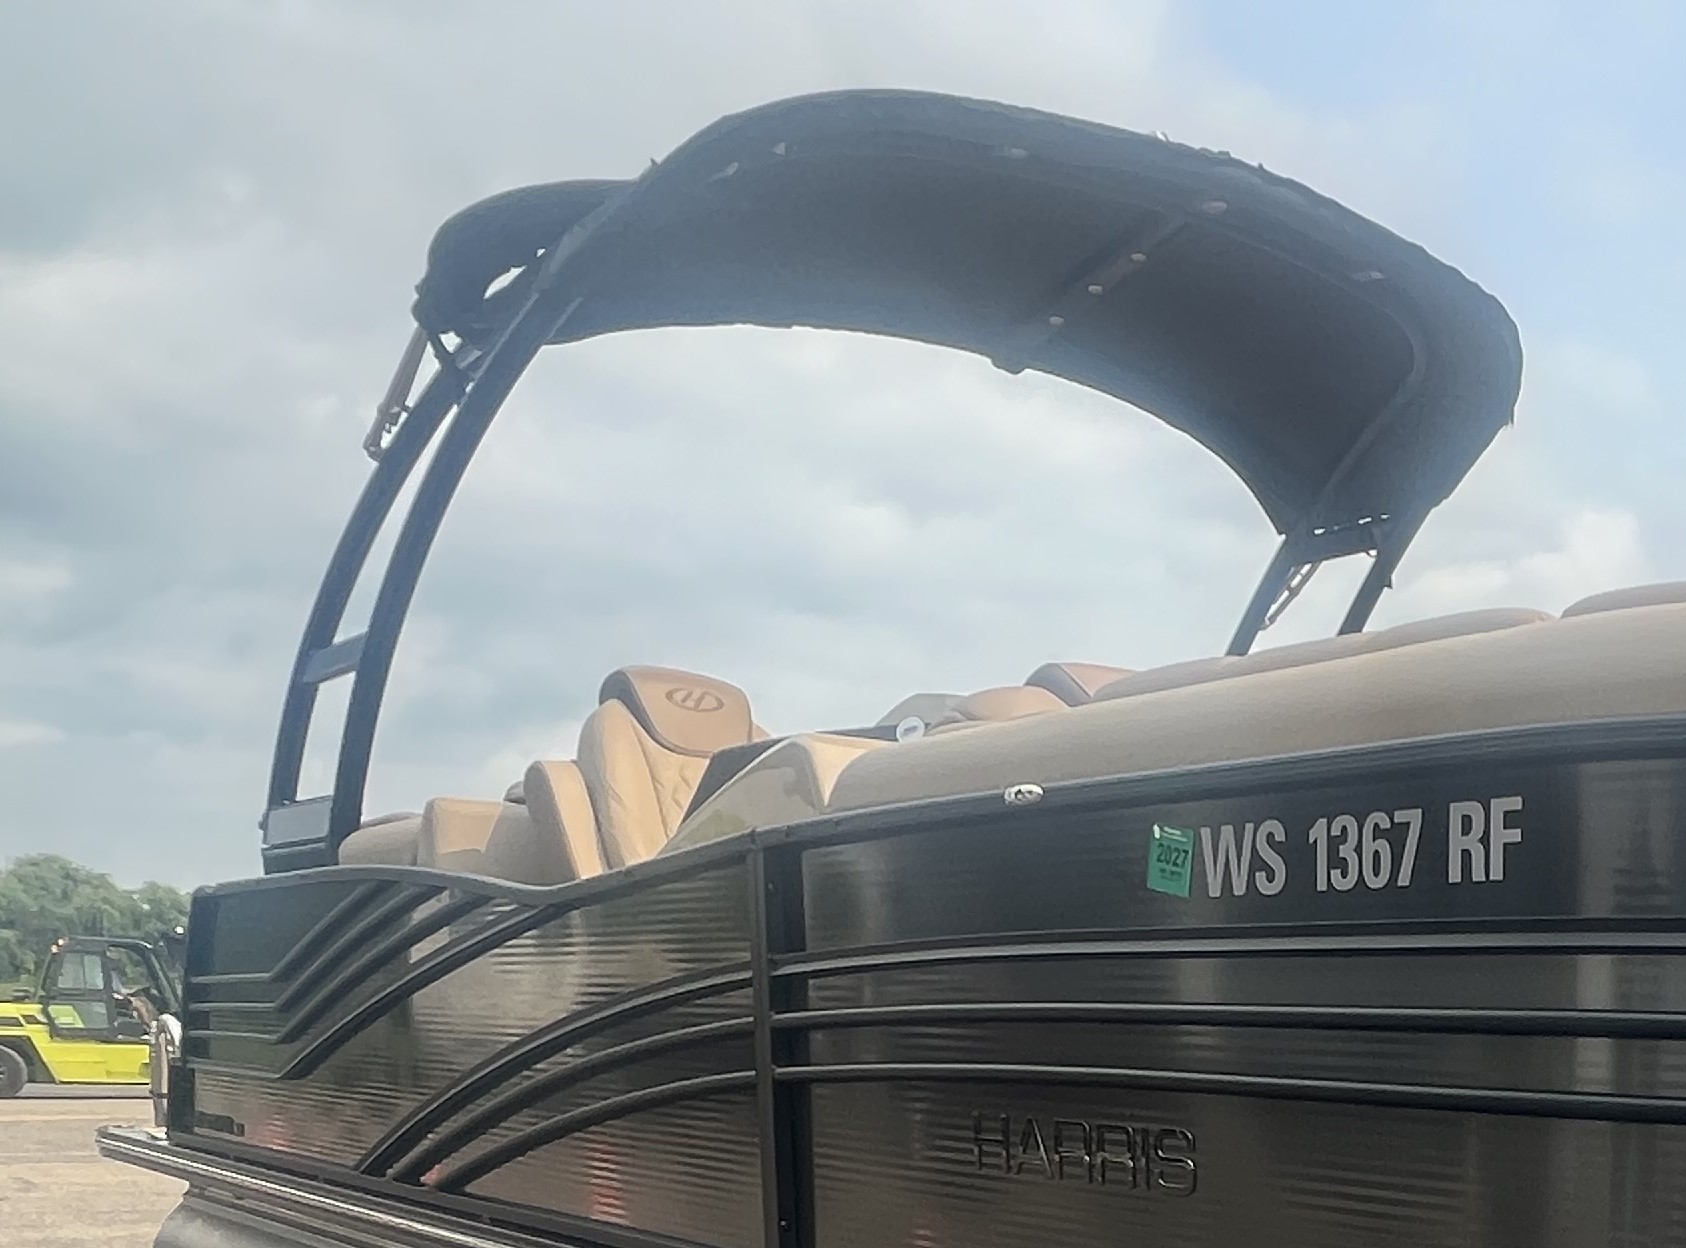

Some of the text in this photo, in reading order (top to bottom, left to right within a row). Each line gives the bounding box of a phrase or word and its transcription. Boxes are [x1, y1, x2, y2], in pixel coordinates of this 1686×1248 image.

[1156, 842, 1190, 869] 2027
[1200, 796, 1523, 898] WS 1367 RF
[971, 1110, 1198, 1198] HARRIS
